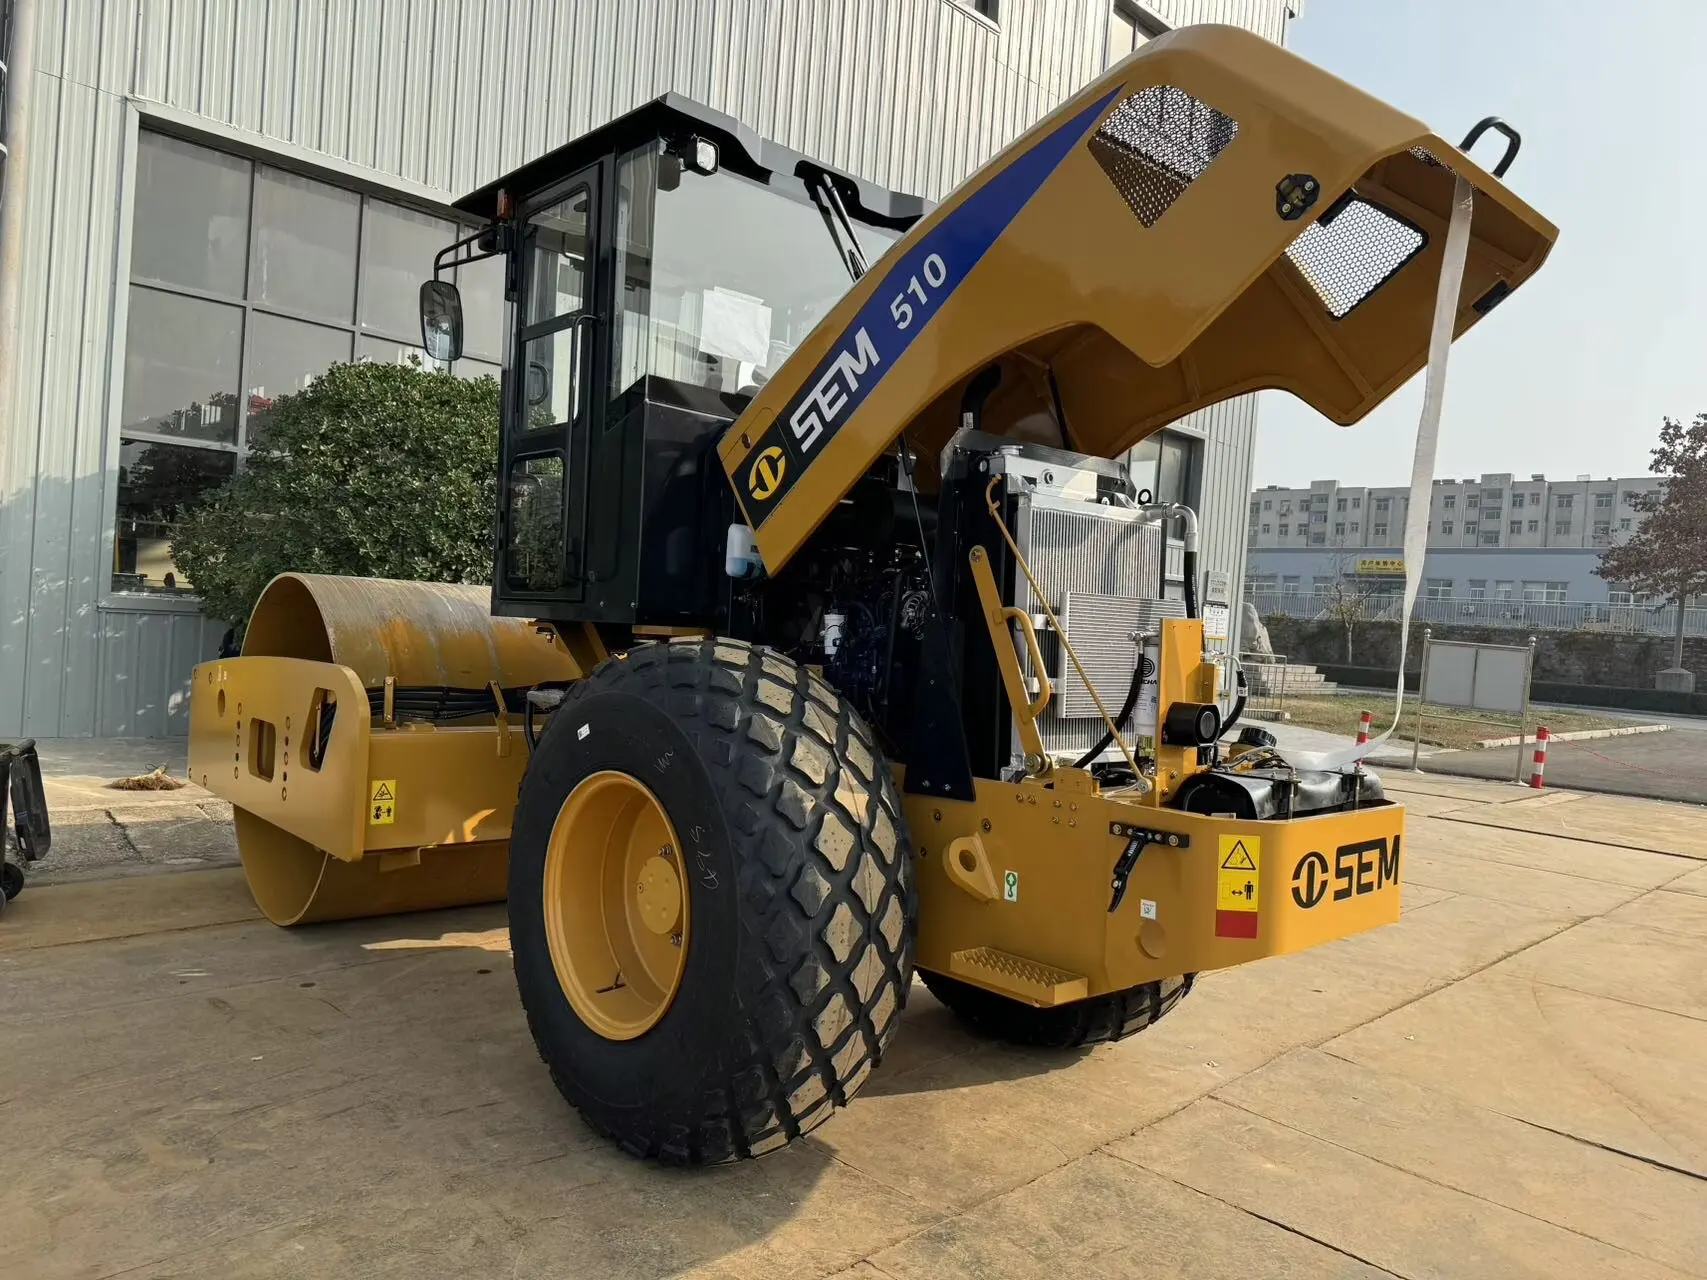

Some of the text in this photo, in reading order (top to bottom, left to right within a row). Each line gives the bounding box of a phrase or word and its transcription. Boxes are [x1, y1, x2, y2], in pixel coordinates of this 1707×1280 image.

[789, 253, 947, 453] SEM 510
[1333, 834, 1401, 902] SEM
